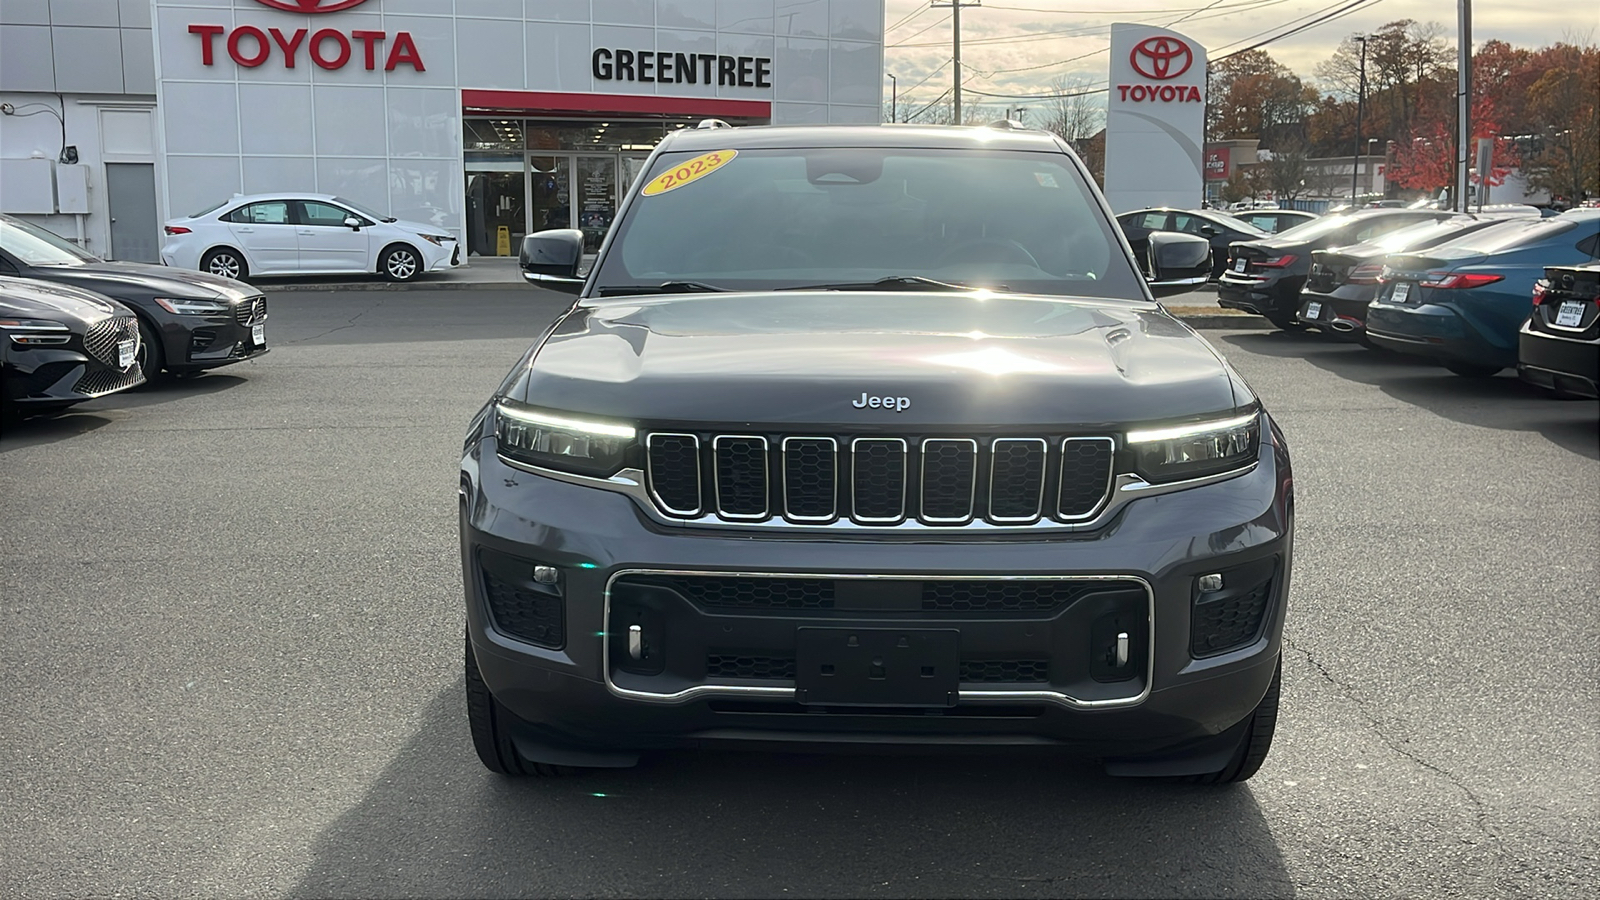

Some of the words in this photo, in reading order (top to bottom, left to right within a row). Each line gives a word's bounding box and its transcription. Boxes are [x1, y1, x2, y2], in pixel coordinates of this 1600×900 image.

[188, 24, 426, 72] TOYOTA
[592, 47, 771, 88] GREENTREE
[1117, 84, 1202, 103] TOYOTA
[660, 153, 722, 190] 2023
[852, 392, 911, 412] Jeep
